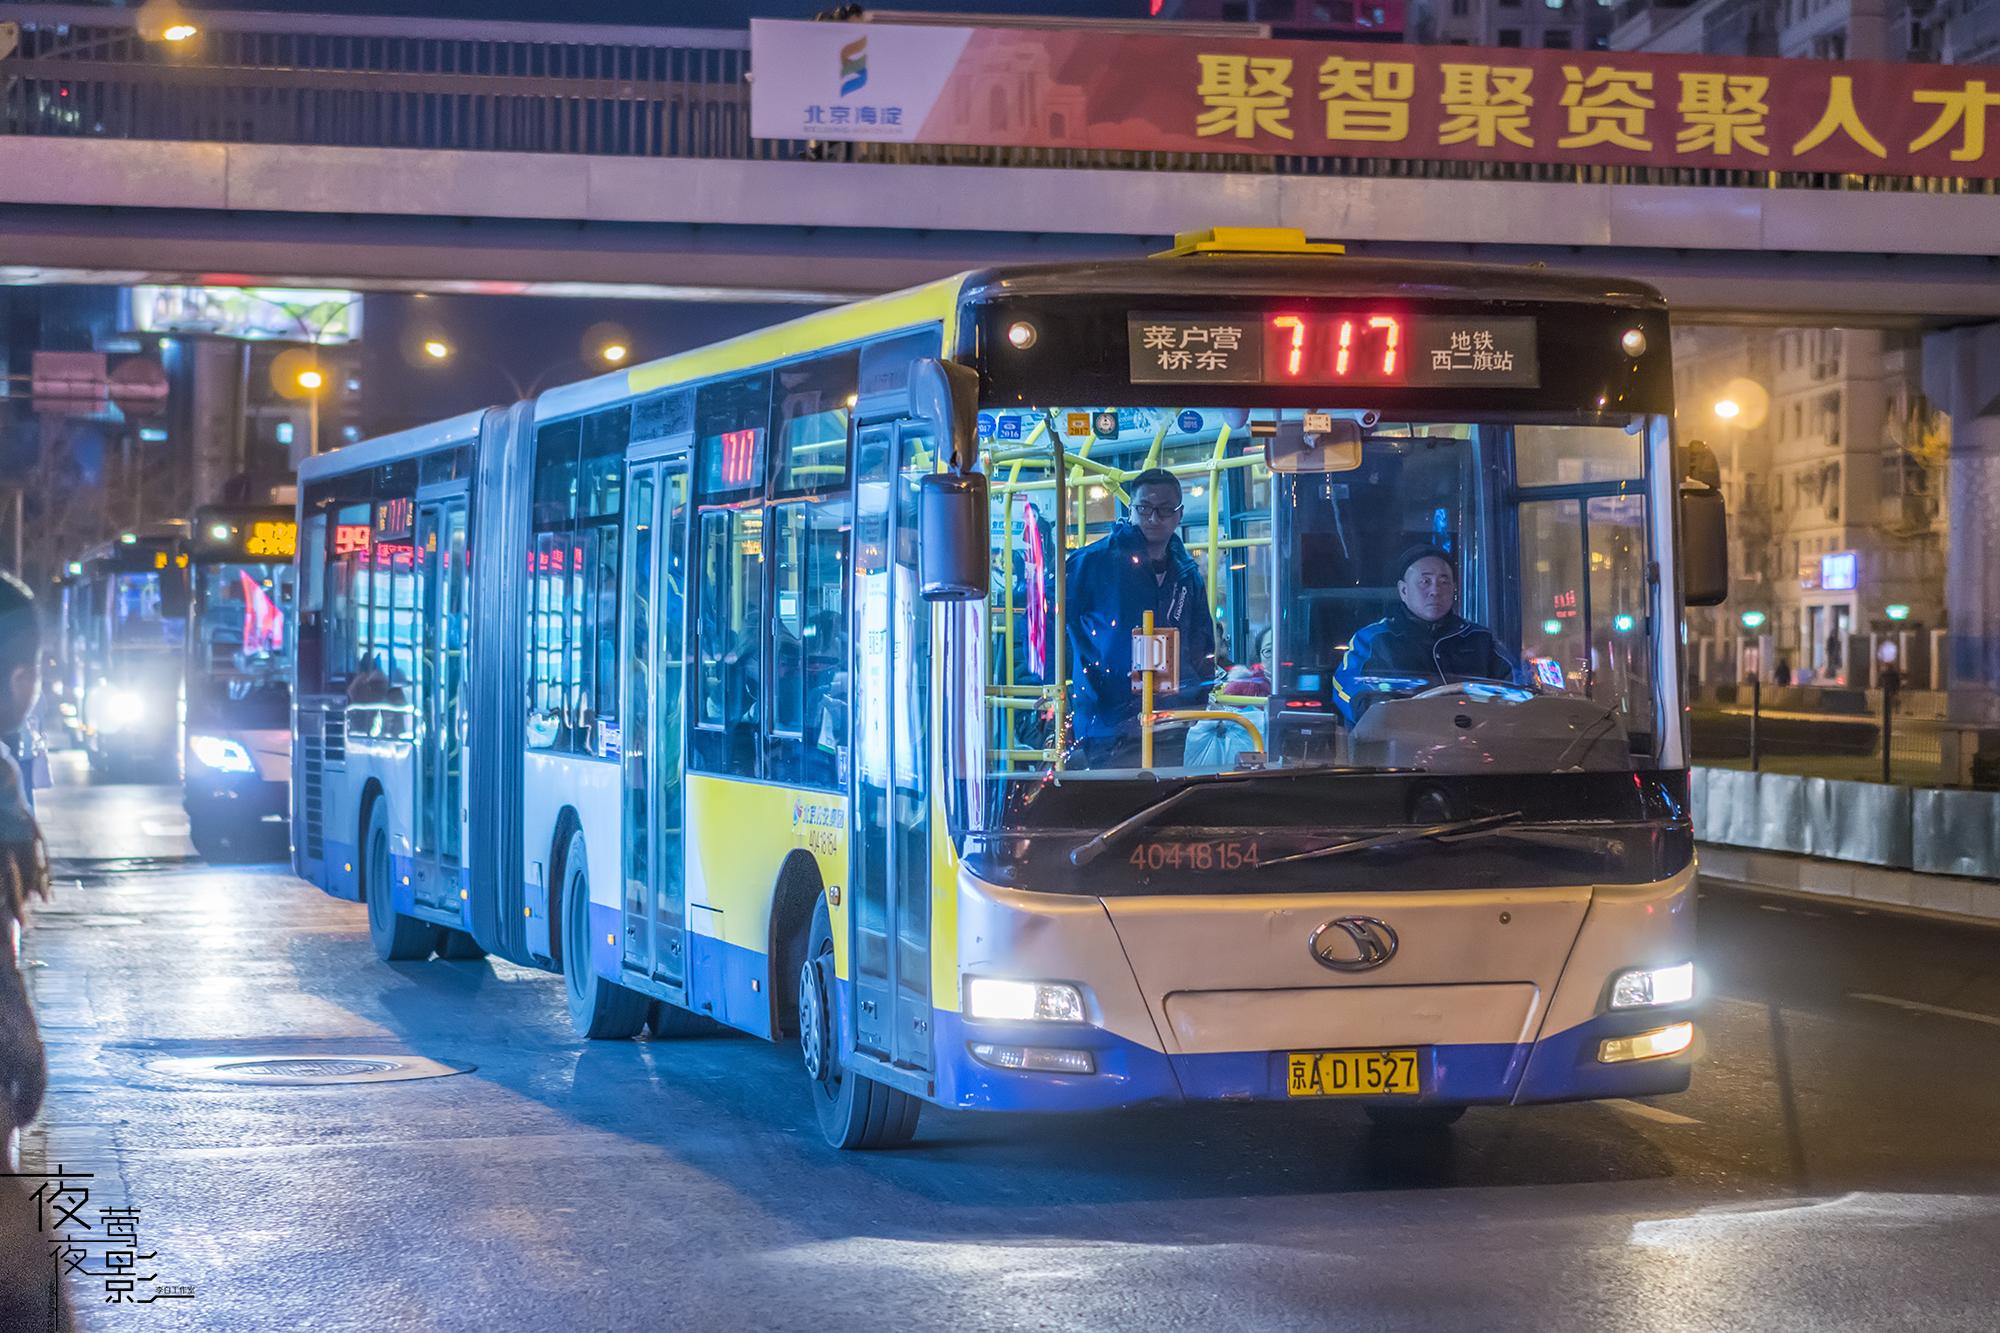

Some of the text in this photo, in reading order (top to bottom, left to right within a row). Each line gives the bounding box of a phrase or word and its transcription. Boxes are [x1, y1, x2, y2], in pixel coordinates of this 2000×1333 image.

[803, 105, 903, 125] 北京海淀
[1196, 54, 2000, 163] 聚智聚资聚人才
[1143, 325, 1243, 350] 菜户营
[1273, 315, 1400, 376] 717
[1450, 331, 1494, 351] 地铁
[1157, 350, 1228, 371] 桥东
[1431, 350, 1514, 371] 西二旗站
[1000, 430, 1020, 439] 2016
[1129, 841, 1260, 871] 40418154
